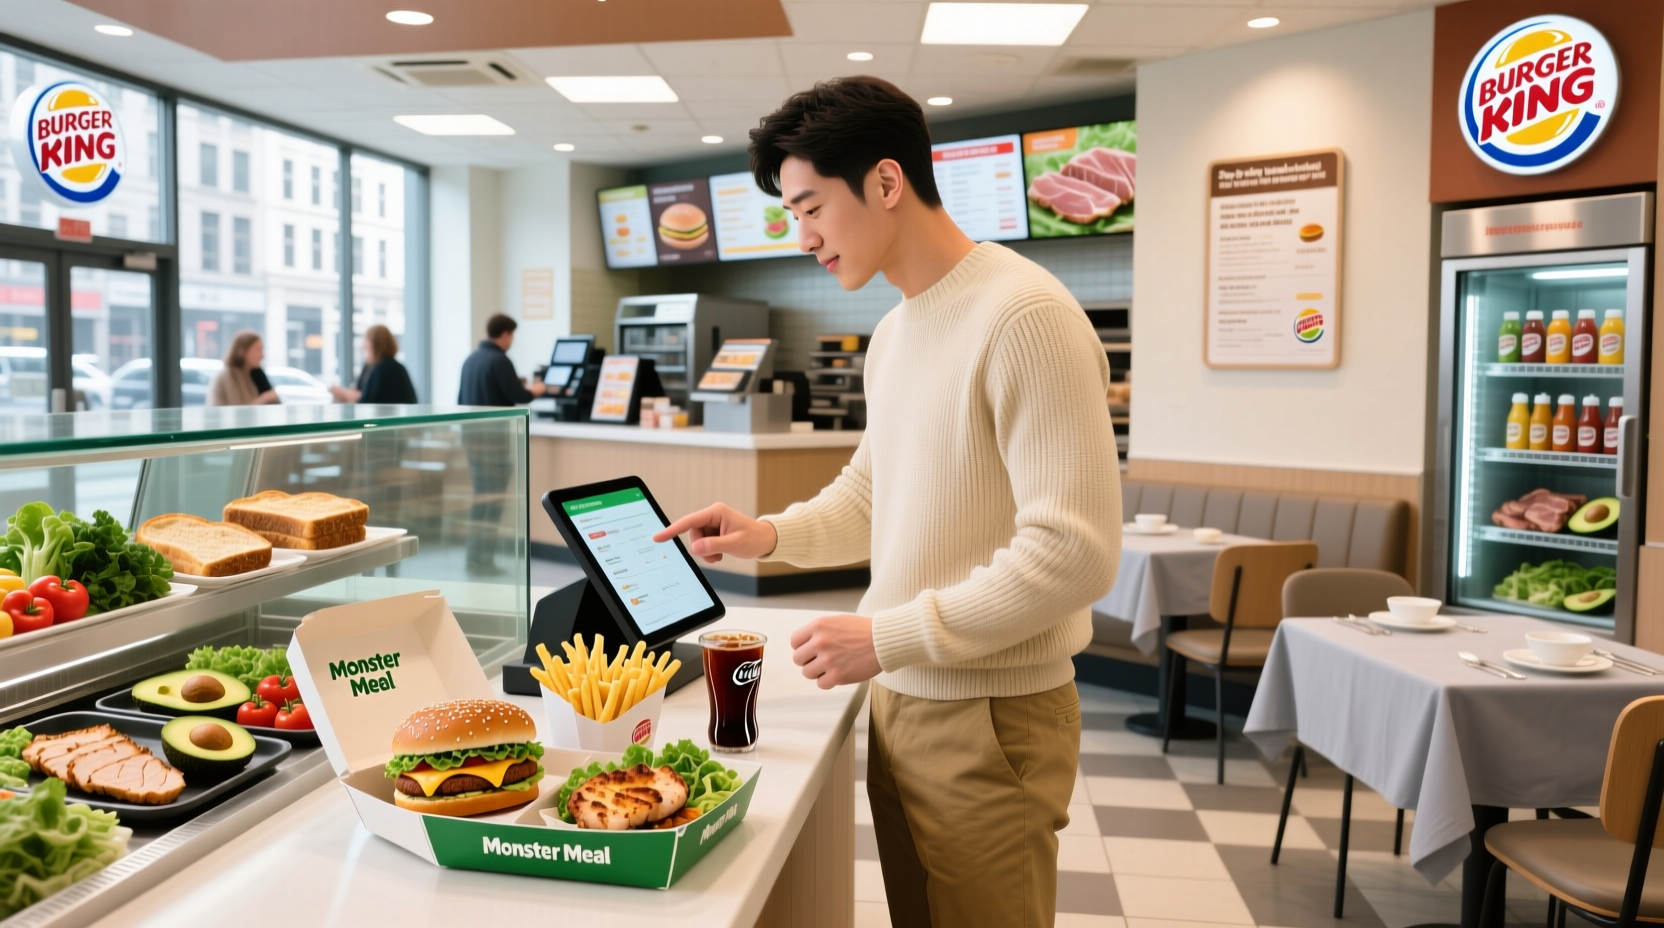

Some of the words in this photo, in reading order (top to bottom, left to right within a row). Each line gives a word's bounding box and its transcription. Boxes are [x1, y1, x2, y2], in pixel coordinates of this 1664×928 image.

[1478, 41, 1592, 107] BURGER
[1480, 67, 1596, 142] KING
[38, 111, 112, 140] BURGER
[40, 131, 115, 172] KING
[328, 652, 400, 681] Monster
[349, 670, 396, 697] Meal
[482, 836, 561, 861] Monster
[563, 844, 611, 865] Meal
